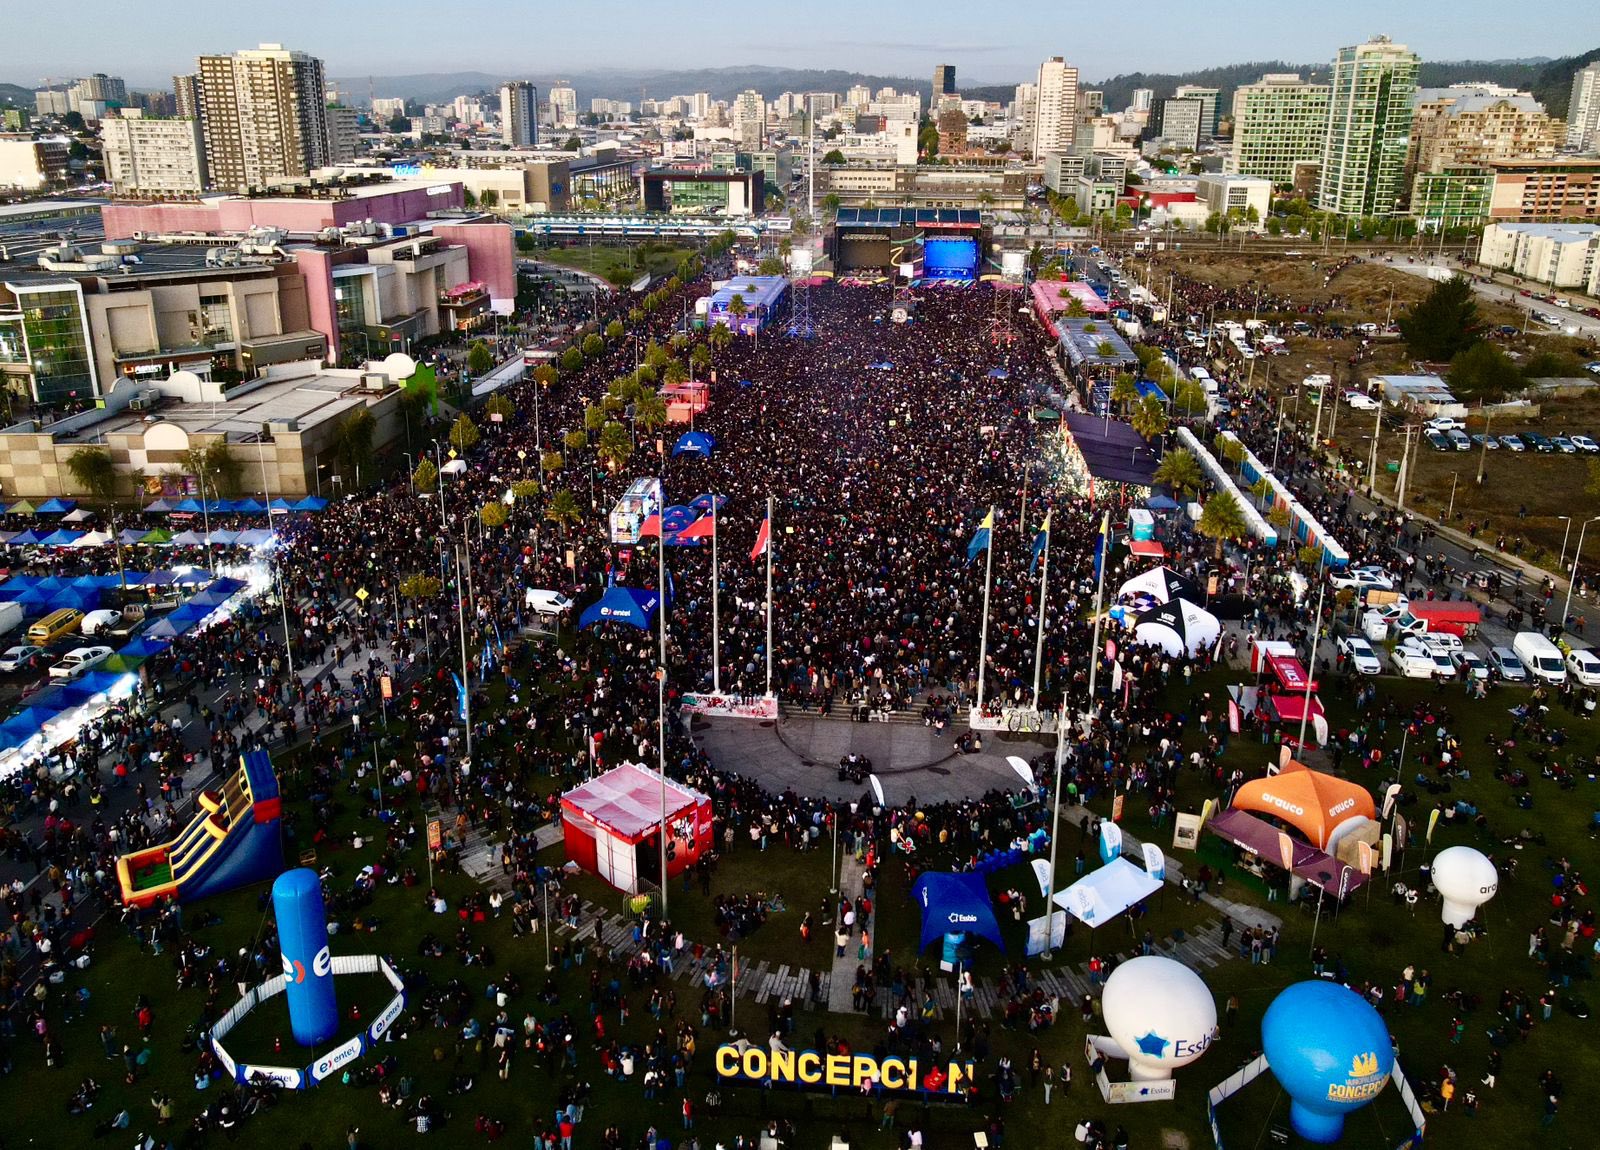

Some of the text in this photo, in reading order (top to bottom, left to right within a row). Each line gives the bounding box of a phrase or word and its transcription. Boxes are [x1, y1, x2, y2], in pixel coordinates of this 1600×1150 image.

[1262, 792, 1304, 816] arauco
[1329, 798, 1355, 817] arauco
[1233, 838, 1259, 855] arauco
[959, 914, 977, 922] Essbio
[385, 1002, 401, 1022] entel
[333, 1045, 357, 1064] entel
[715, 1044, 974, 1093] CONCEPCIN
[1150, 1087, 1171, 1095] Essbio
